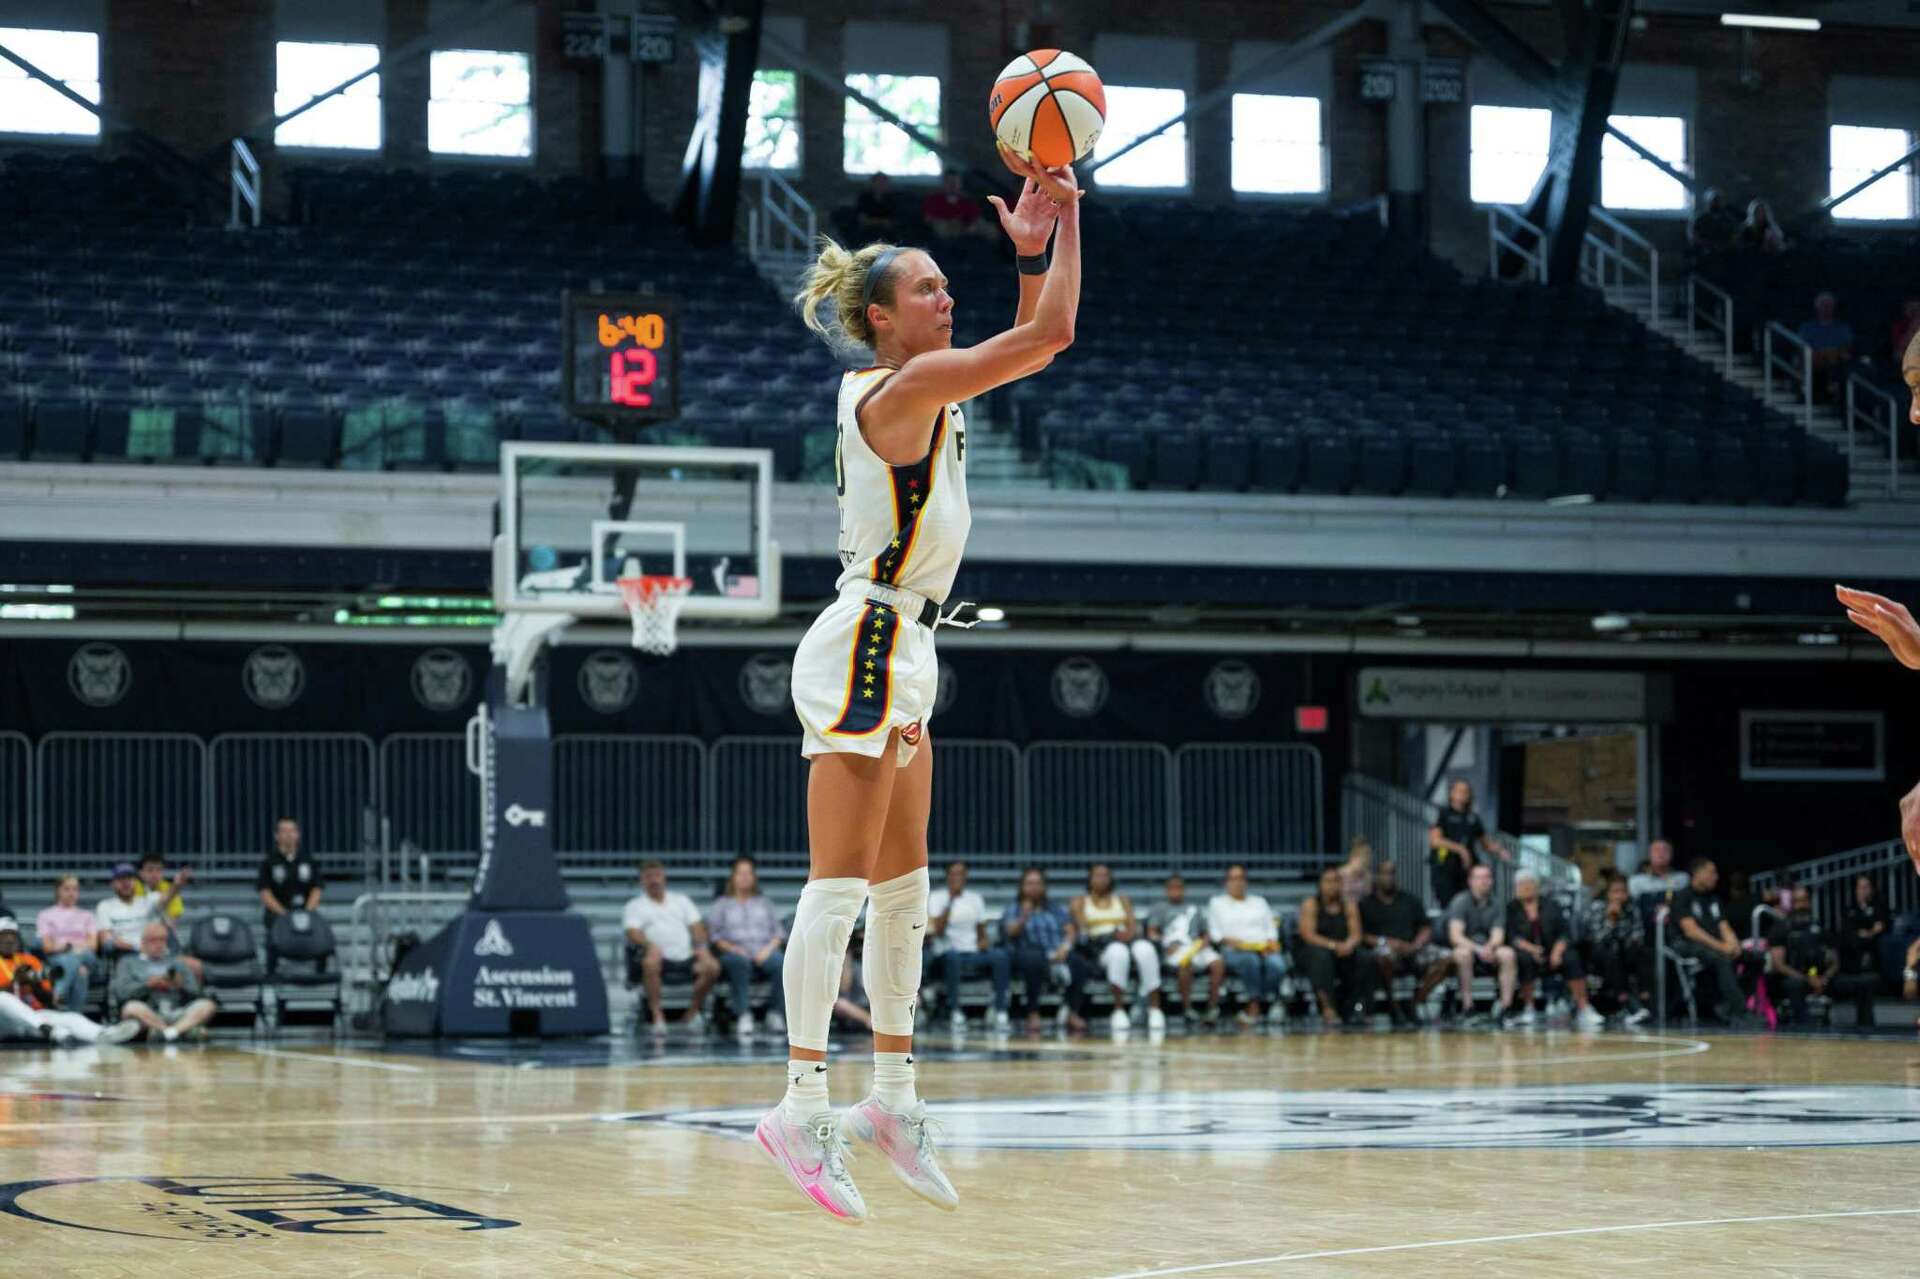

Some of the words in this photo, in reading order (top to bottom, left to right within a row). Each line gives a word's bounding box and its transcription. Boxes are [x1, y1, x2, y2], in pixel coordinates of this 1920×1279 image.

[598, 313, 665, 350] 6:40
[610, 348, 657, 407] 12
[474, 966, 574, 986] Ascension
[473, 987, 500, 1008] St.
[501, 987, 578, 1008] Vincent
